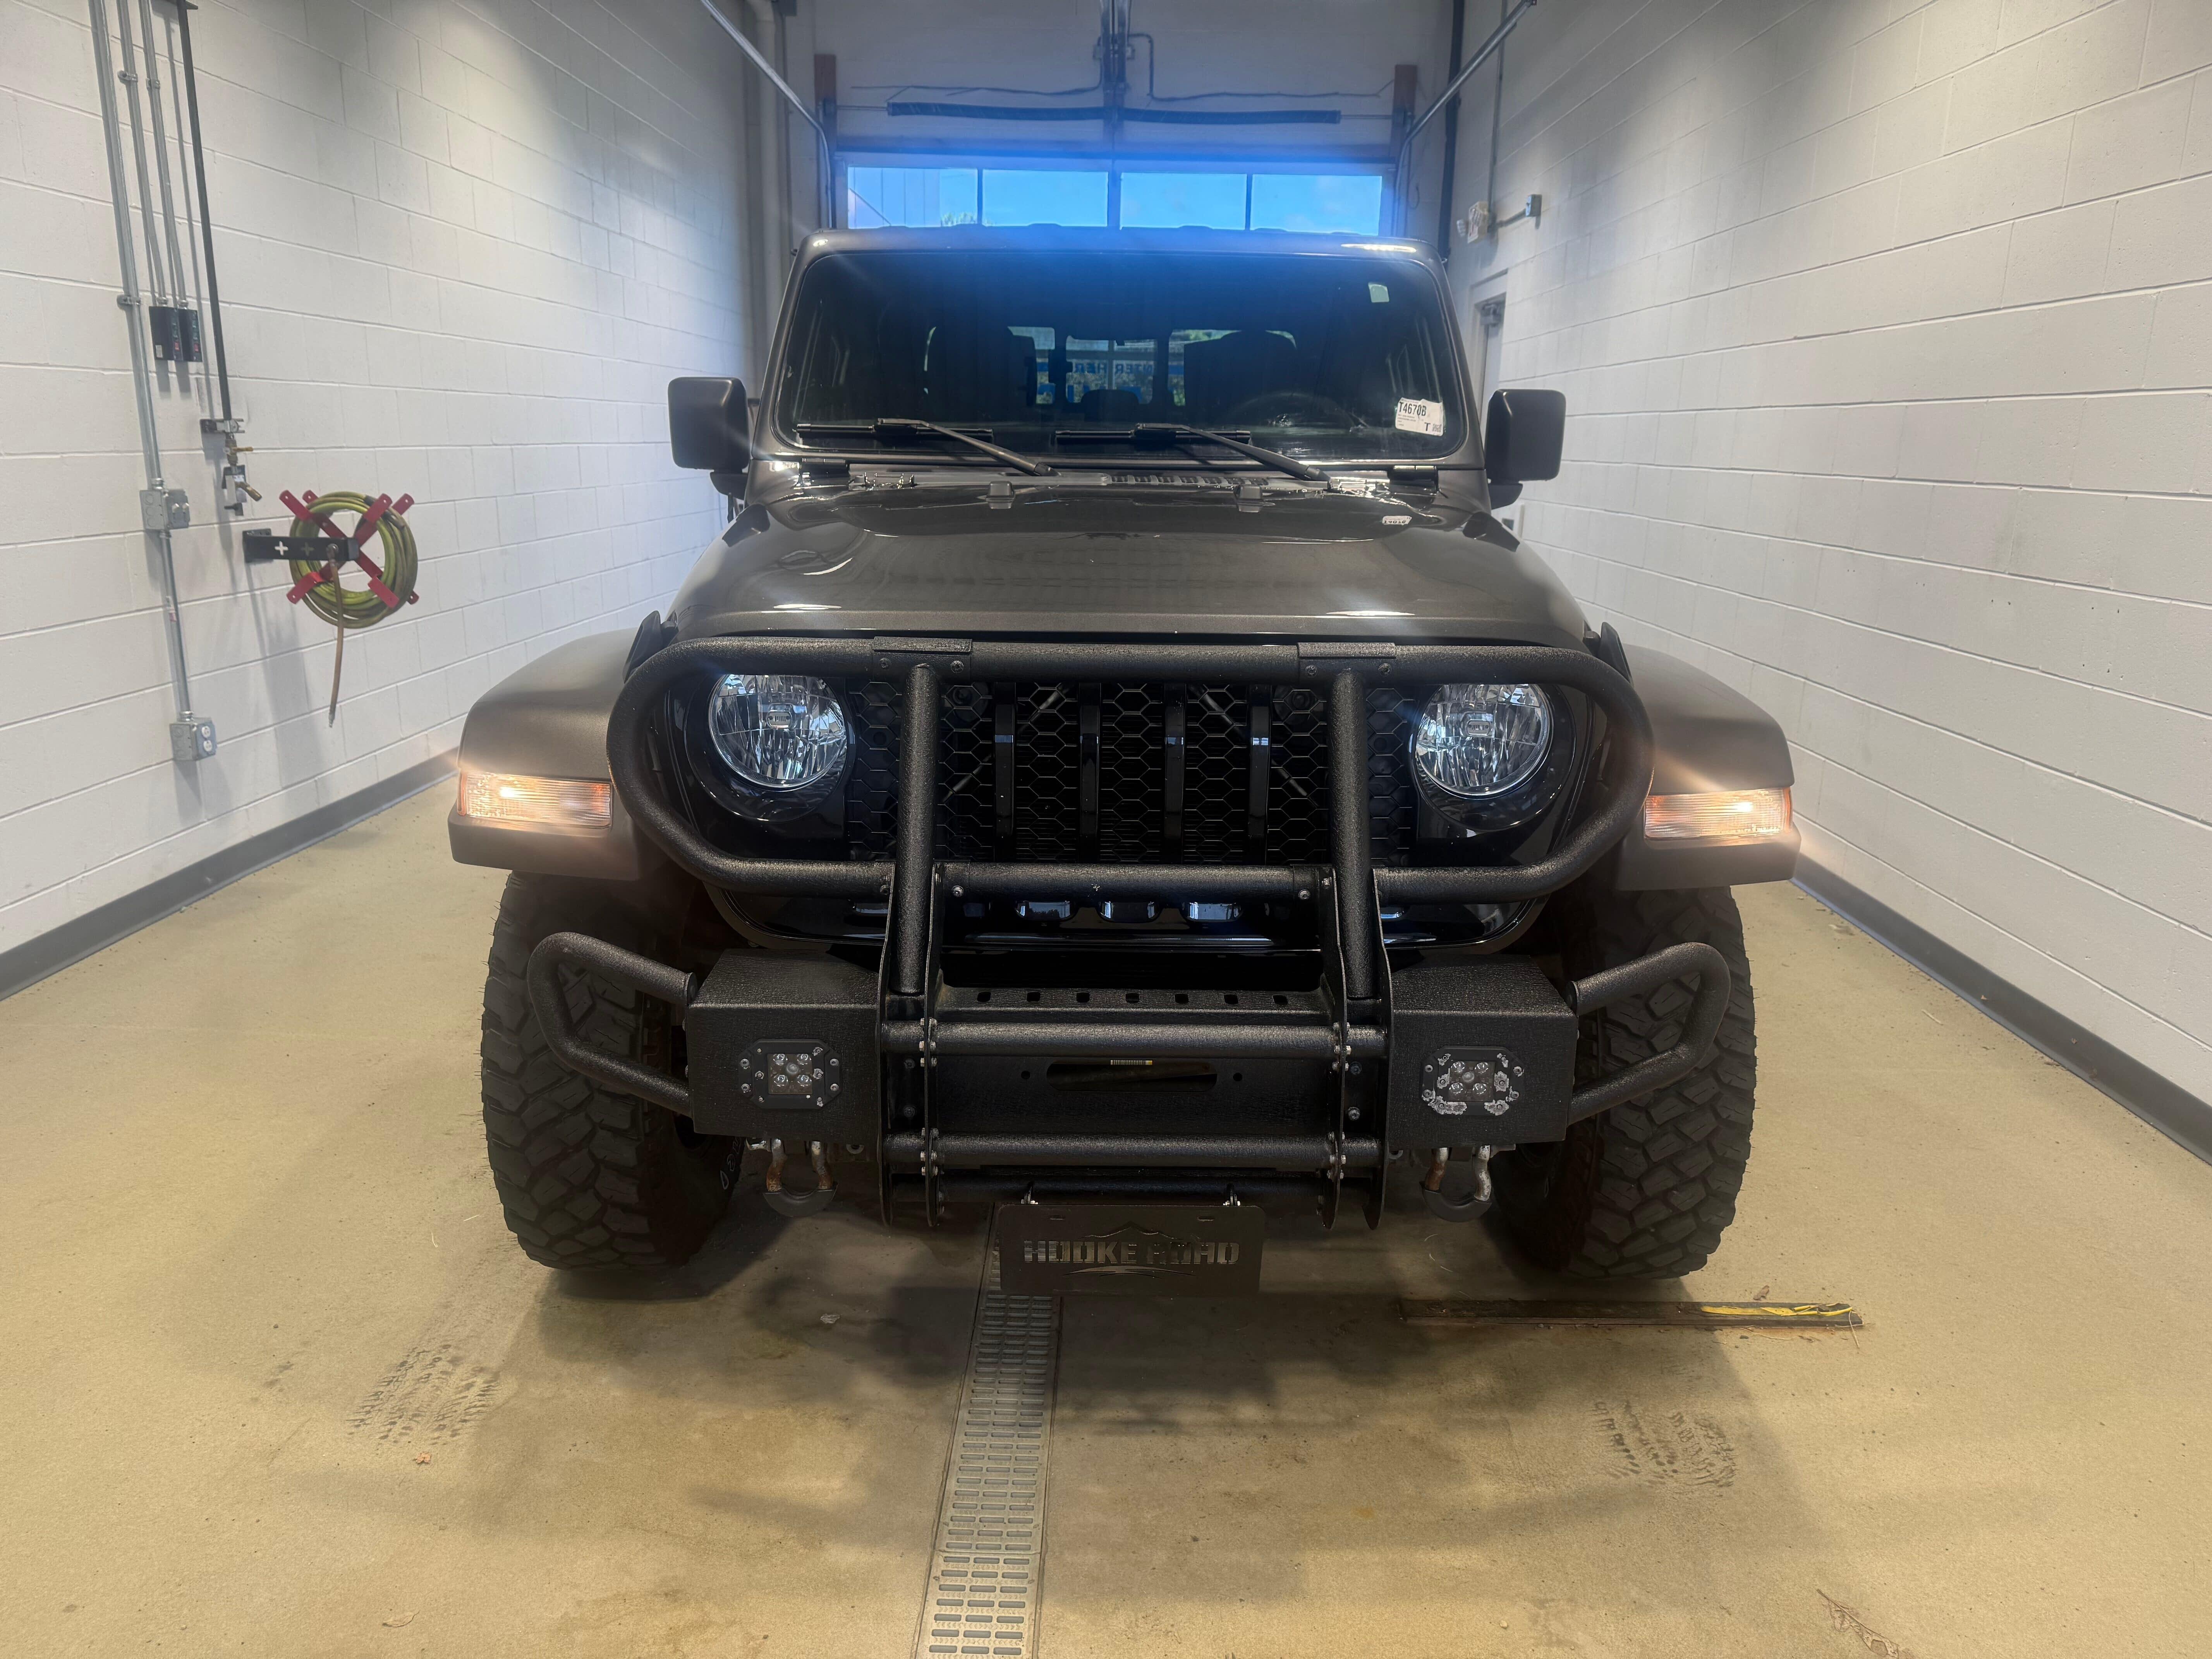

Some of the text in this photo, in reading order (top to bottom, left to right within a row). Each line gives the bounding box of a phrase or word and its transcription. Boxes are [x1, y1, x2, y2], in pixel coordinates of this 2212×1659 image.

[1424, 422, 1431, 431] T
[1024, 1240, 1240, 1264] HOOKE ROAD
